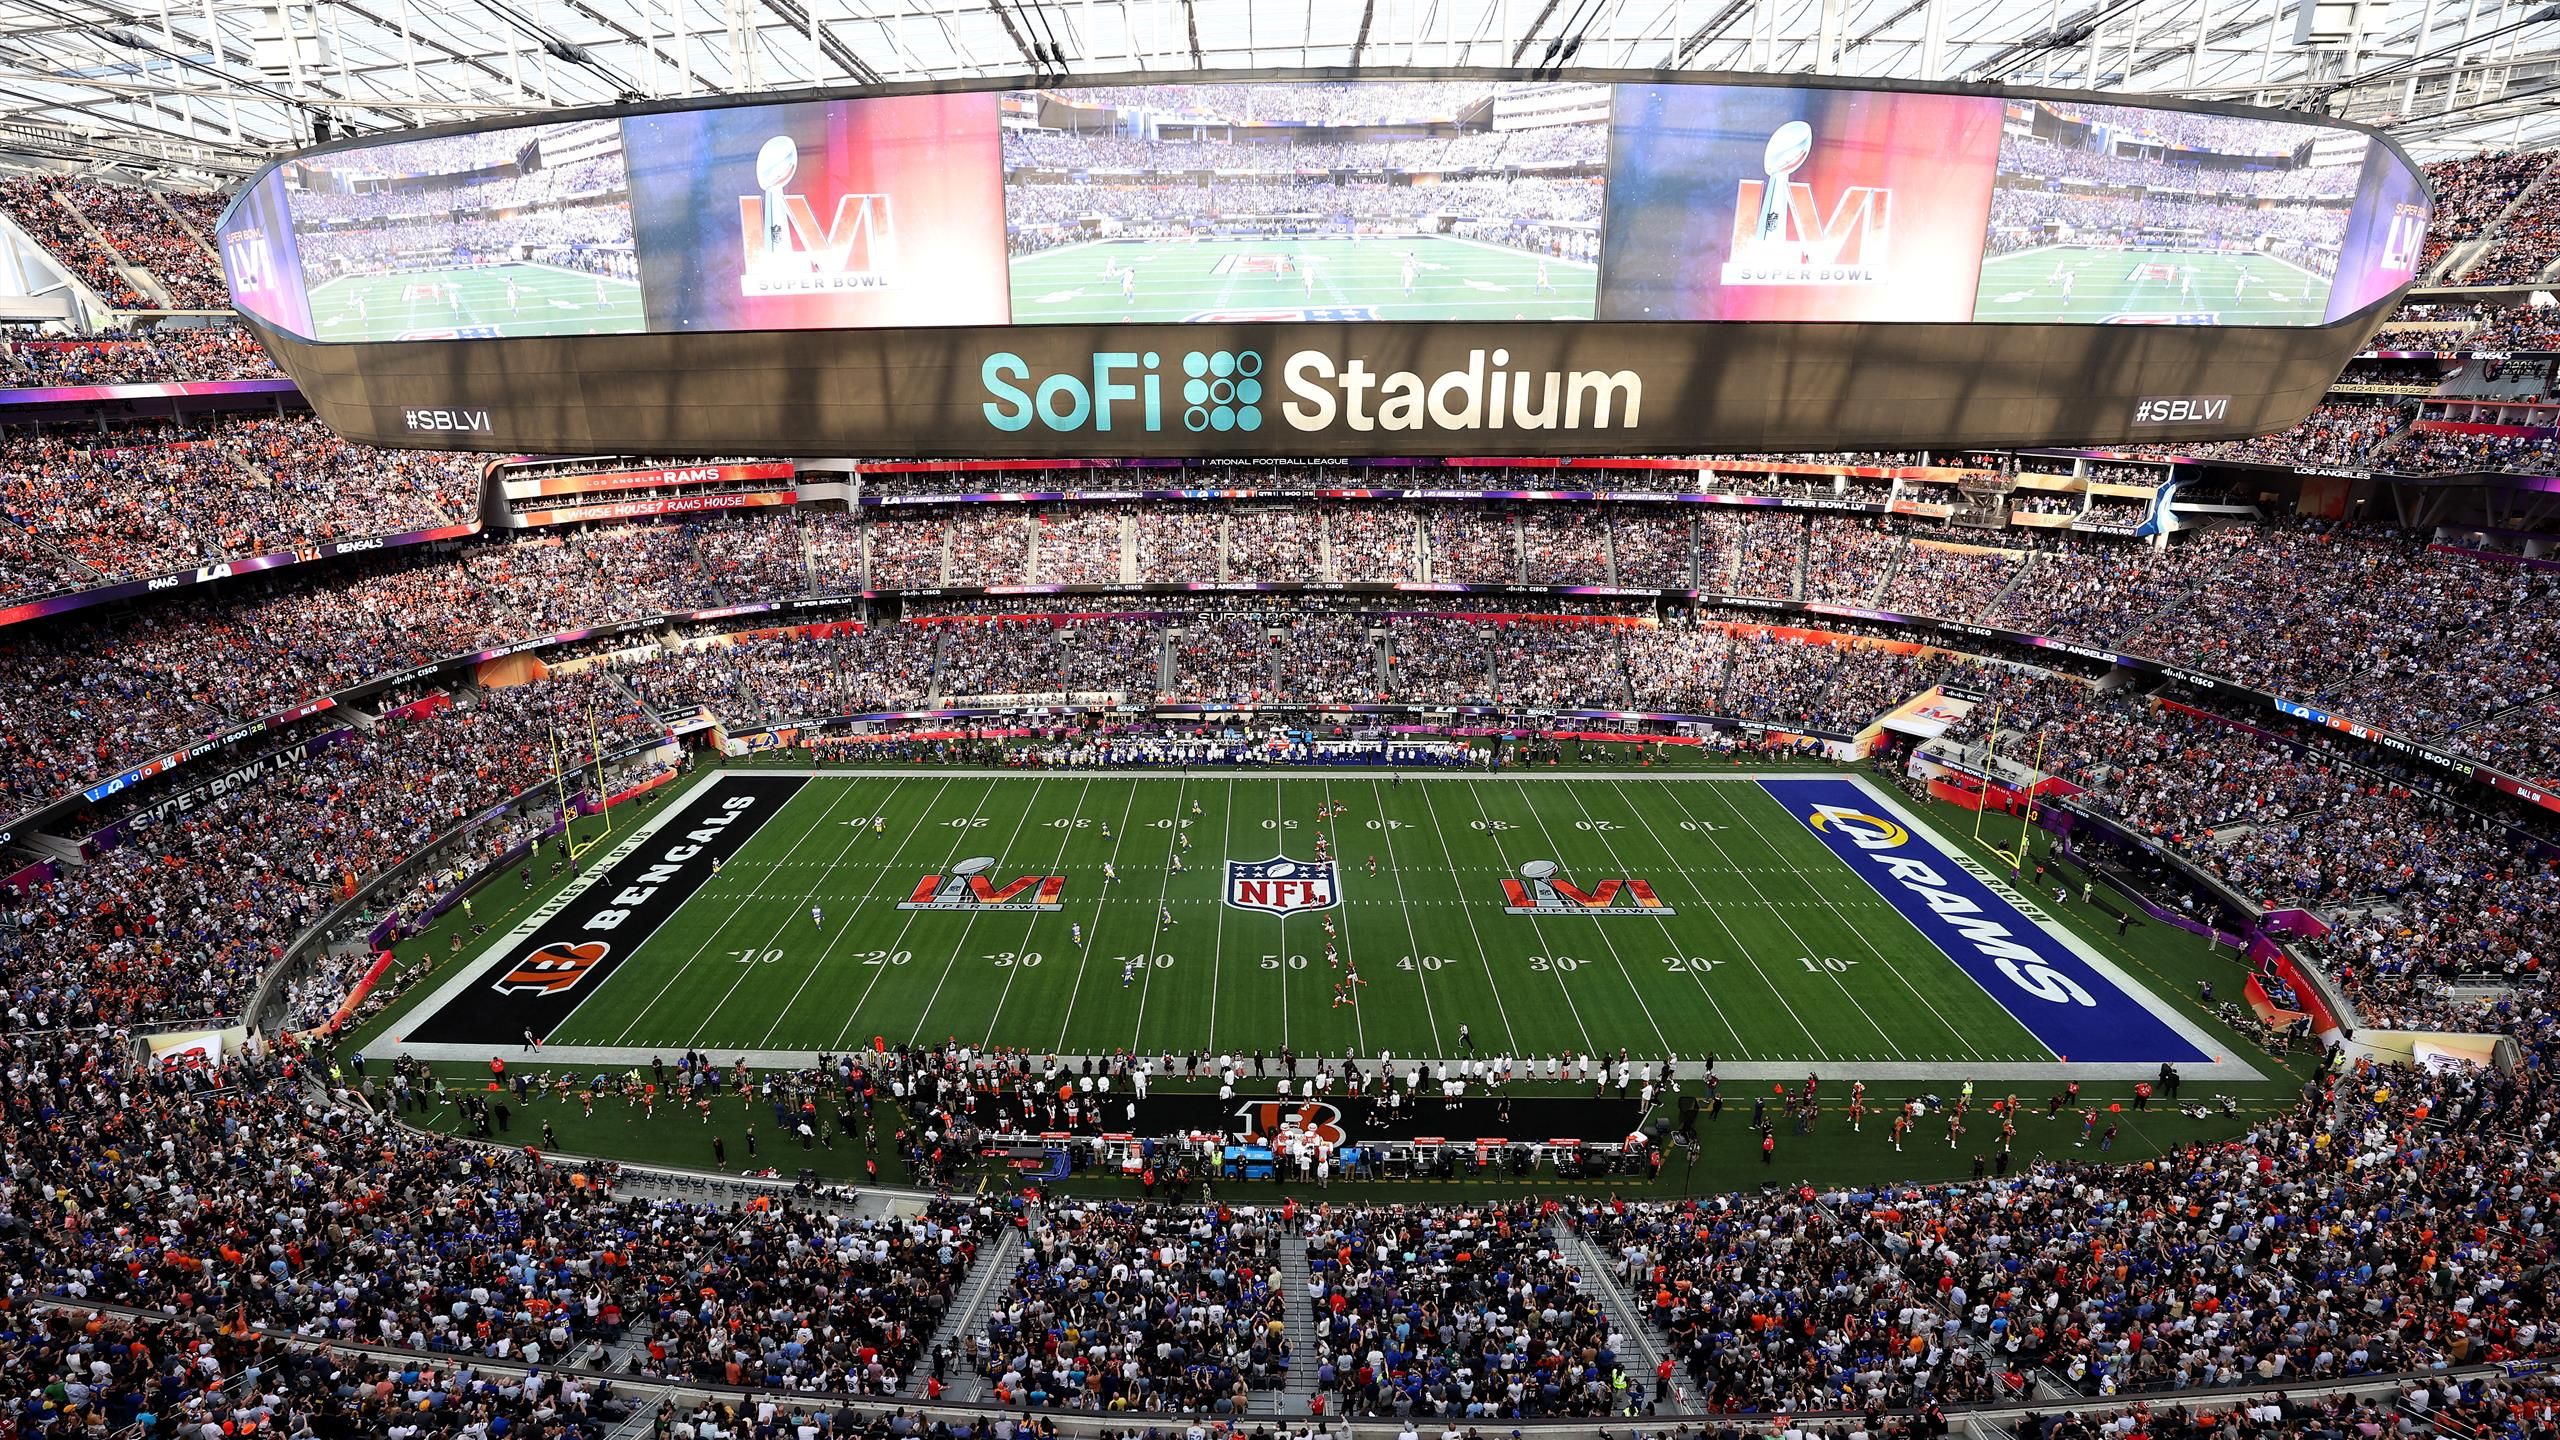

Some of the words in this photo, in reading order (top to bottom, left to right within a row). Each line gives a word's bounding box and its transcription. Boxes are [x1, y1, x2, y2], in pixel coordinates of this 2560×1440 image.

[2395, 203, 2417, 215] SUPER
[1729, 179, 1892, 264] LVI
[226, 231, 243, 245] SUPER
[739, 193, 896, 274] LVI
[1742, 268, 1810, 281] SUPER
[1820, 269, 1873, 281] BOWL
[760, 278, 824, 290] SUPER
[834, 276, 888, 288] BOWL
[2471, 352, 2512, 360] BENGALS
[981, 351, 1160, 433] SoFi
[1282, 349, 1642, 431] Stadium
[2378, 385, 2432, 394] 541-9222
[2136, 398, 2226, 423] #SBLVI
[406, 410, 491, 434] #SBLVI
[612, 476, 661, 484] ANGELES
[663, 468, 719, 483] RAMS
[2294, 466, 2318, 476] LOS
[2319, 469, 2371, 480] ANGELES
[567, 506, 611, 519] WHOSE
[615, 502, 663, 516] HOUSE?
[667, 499, 701, 511] RAMS
[704, 495, 746, 508] HOUSE!
[1781, 499, 1816, 509] SUPER
[1818, 501, 1850, 510] BOWL
[336, 538, 384, 553] BENGALS
[148, 575, 178, 591] RAMS
[1619, 588, 1662, 596] ANGELES
[699, 609, 733, 618] SUPER
[735, 604, 765, 613] BOWL
[1814, 605, 1851, 615] SUPER
[1852, 609, 1881, 618] BOWL
[642, 617, 664, 628] CISCO
[1967, 627, 1992, 636] CISCO
[491, 645, 511, 657] LOS
[512, 637, 556, 654] ANGELES
[2046, 641, 2065, 651] LOS
[2067, 645, 2117, 663] ANGELES
[417, 664, 438, 677] CISCO
[2189, 676, 2214, 688] CISCO
[681, 710, 696, 718] CISCO
[766, 724, 791, 732] SUPER
[793, 722, 815, 730] BOWL
[1739, 721, 1765, 730] SUPER
[1766, 725, 1791, 733] BOWL
[131, 773, 138, 782] 0
[145, 767, 152, 776] 0
[192, 746, 211, 757] QTR
[223, 730, 248, 744] 15:00
[251, 723, 263, 733] 25
[300, 707, 310, 715] BALL
[275, 745, 307, 769] LVI
[2317, 715, 2326, 723] 0
[2332, 719, 2340, 728] 0
[2384, 737, 2405, 750] QTR
[2418, 750, 2450, 766] 15:00
[2455, 764, 2471, 774] 25
[2517, 787, 2530, 799] BALL
[2532, 793, 2541, 802] ON
[570, 769, 583, 778] CISCO
[1942, 760, 1963, 771] SUPER
[1963, 766, 1983, 777] BOWL
[2076, 809, 2090, 819] CISCO
[583, 796, 755, 931] BENGALS
[513, 923, 538, 935] IT
[533, 884, 587, 919] TAKES
[610, 846, 632, 858] OF
[628, 831, 652, 842] US
[1952, 855, 1990, 878] END
[1987, 878, 2053, 924] RACISM
[1238, 881, 1327, 907] NFL
[1869, 854, 2097, 1007] RAMS
[736, 949, 783, 963] 10
[862, 951, 912, 966] 20
[994, 953, 1043, 967] 30
[1260, 955, 1308, 970] 50
[1396, 956, 1443, 970] 40
[1529, 956, 1578, 971] 30
[1662, 957, 1714, 972] 20
[1797, 957, 1848, 972] 10
[2290, 966, 2315, 995] CINCINNATI
[2315, 995, 2333, 1021] BENGALS
